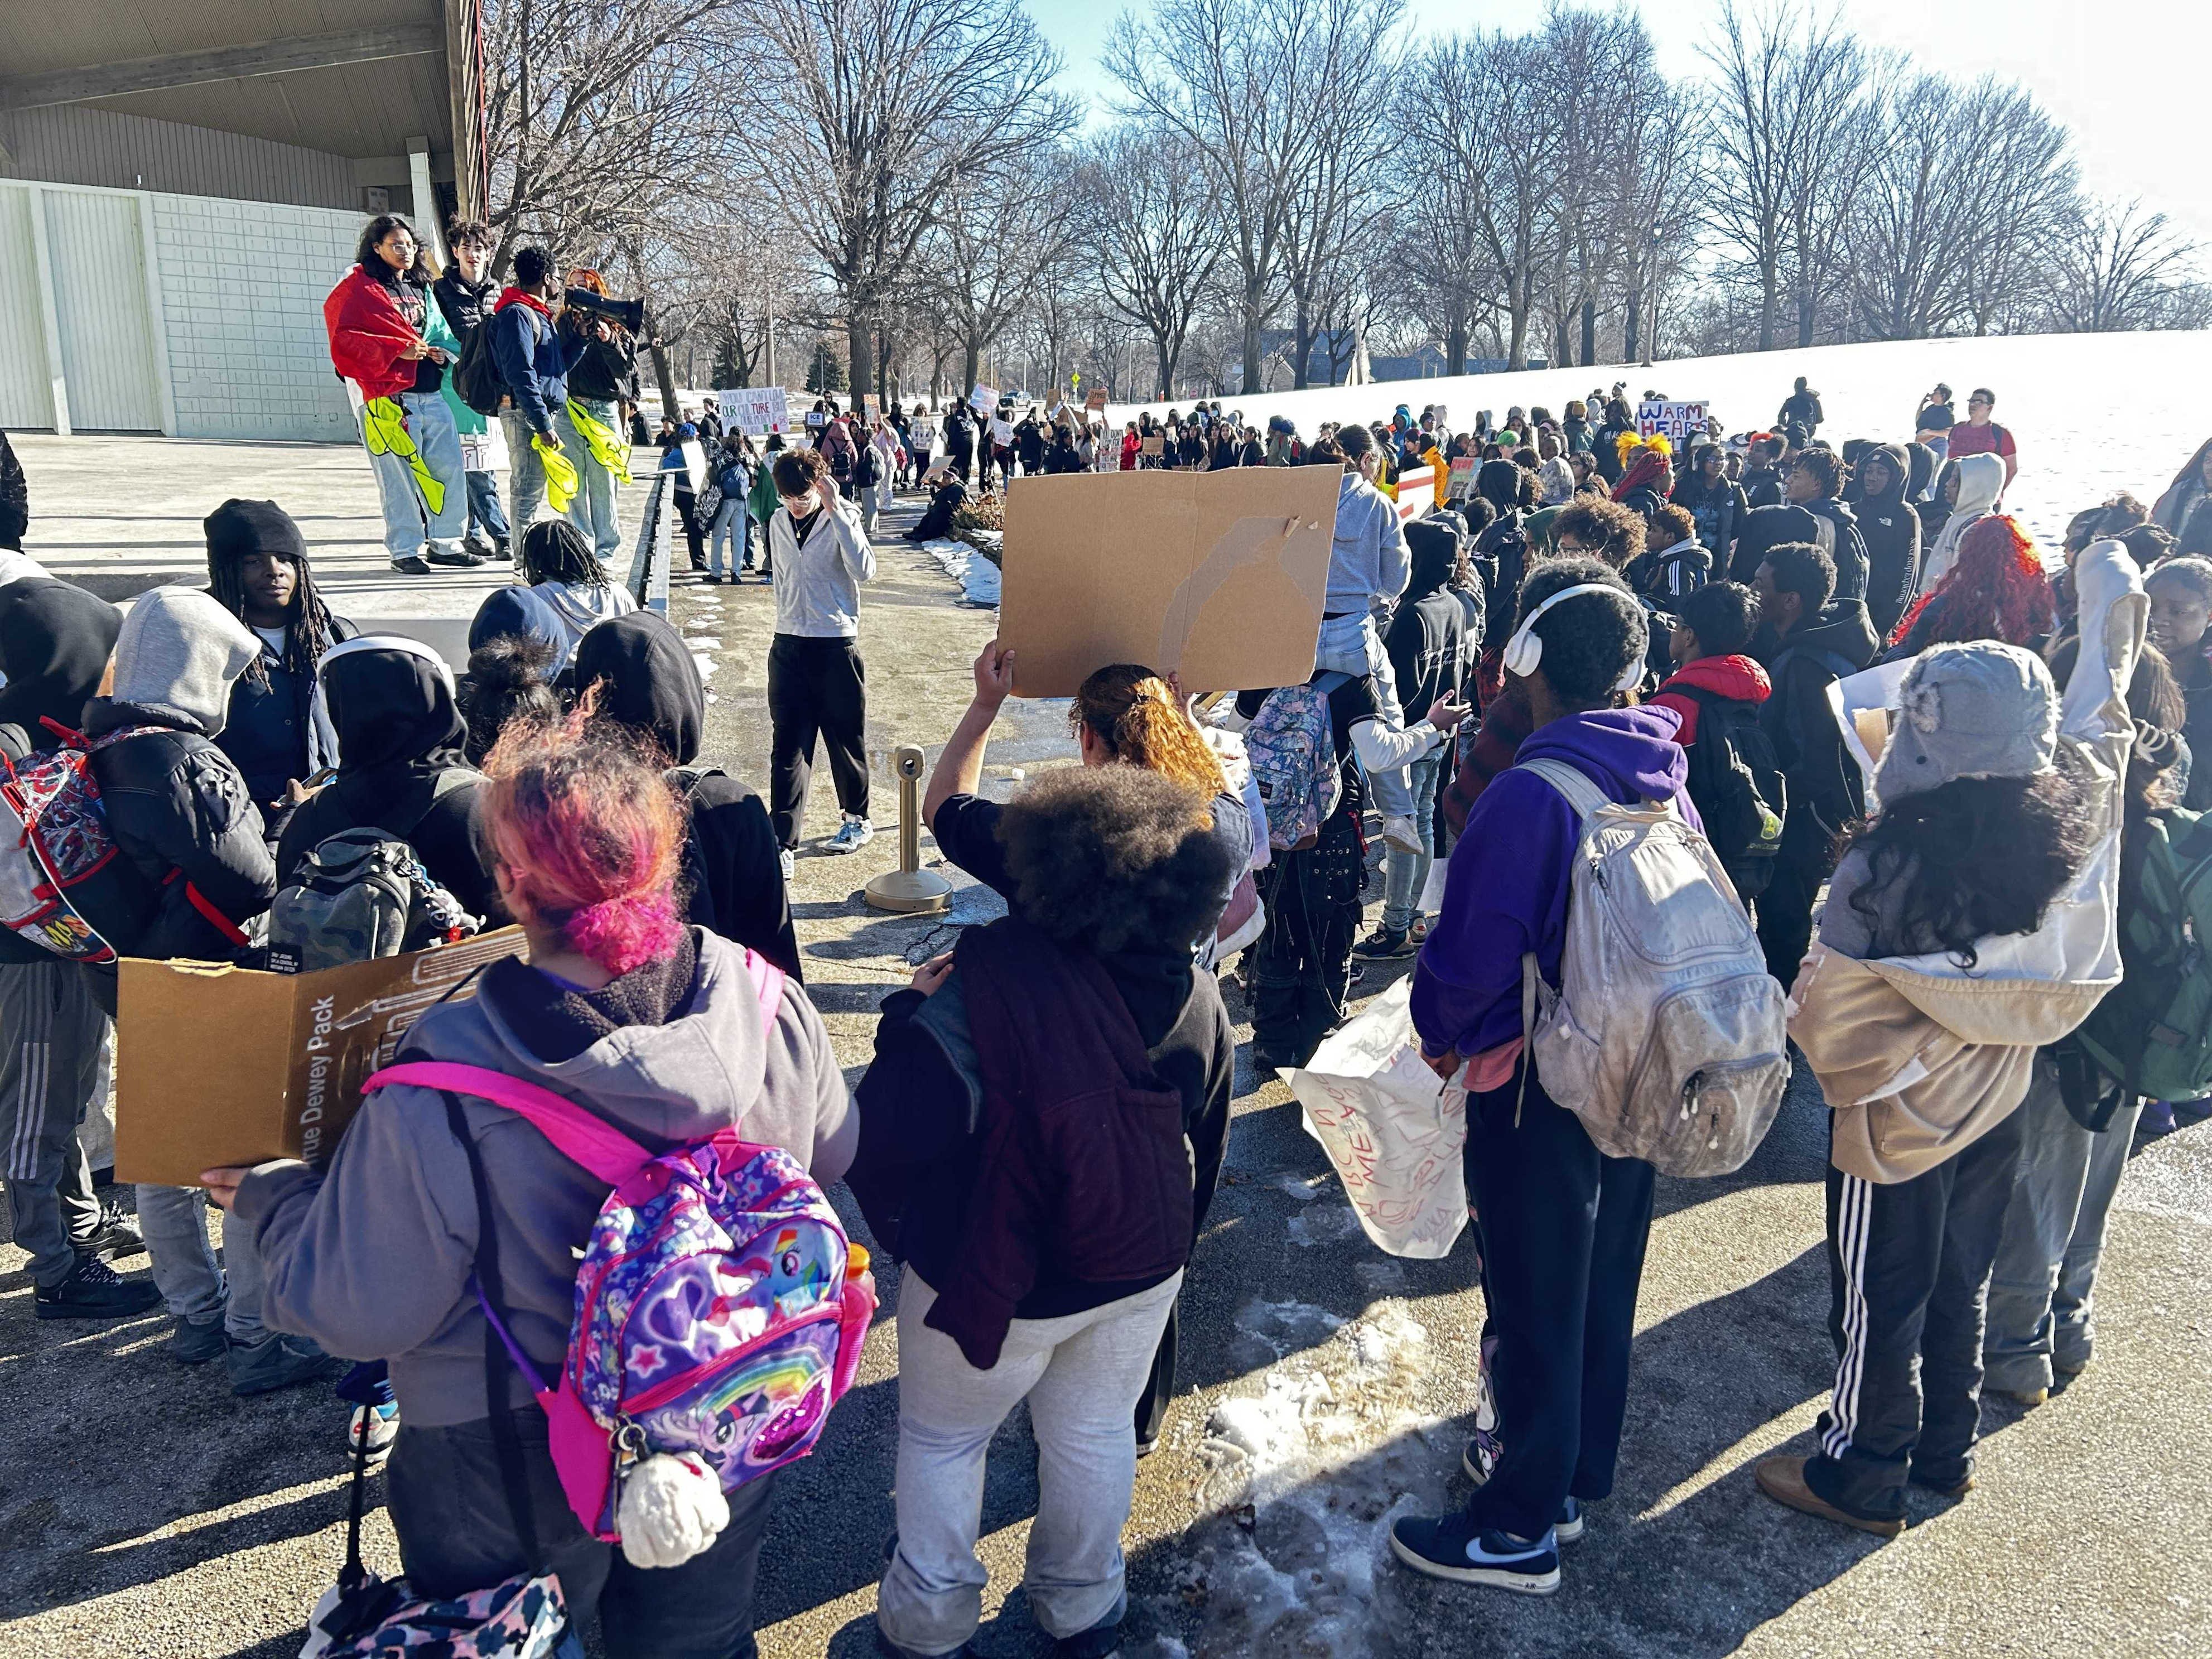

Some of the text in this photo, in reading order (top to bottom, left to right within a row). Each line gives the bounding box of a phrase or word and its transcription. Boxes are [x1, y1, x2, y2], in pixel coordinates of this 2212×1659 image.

[722, 405, 737, 418] OUR
[1639, 404, 1703, 420] WARM
[1641, 419, 1708, 437] HEARTS
[307, 994, 334, 1051] Pack
[300, 1056, 333, 1125] Dewey
